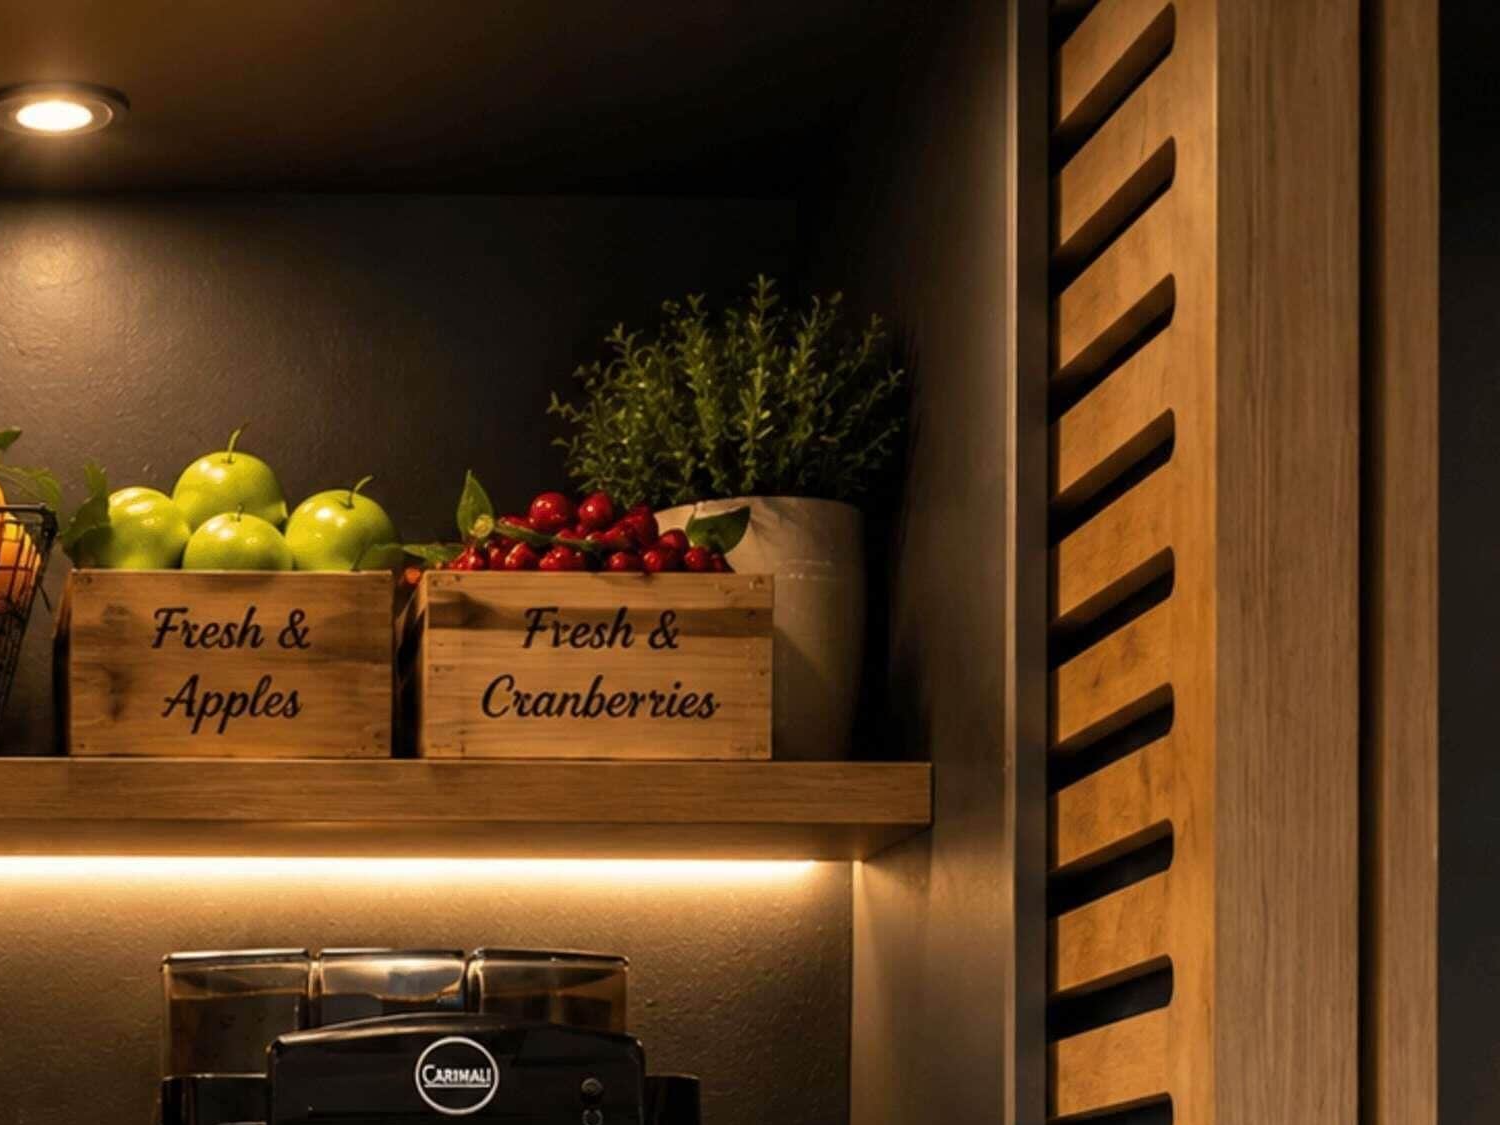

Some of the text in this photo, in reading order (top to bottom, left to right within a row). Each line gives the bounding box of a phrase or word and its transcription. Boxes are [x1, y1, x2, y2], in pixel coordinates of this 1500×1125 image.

[151, 605, 311, 649] Fresh &
[521, 606, 680, 649] Fresh &
[162, 674, 302, 735] Apples
[481, 673, 721, 719] Cranberries
[422, 1064, 492, 1085] CARIMALI
